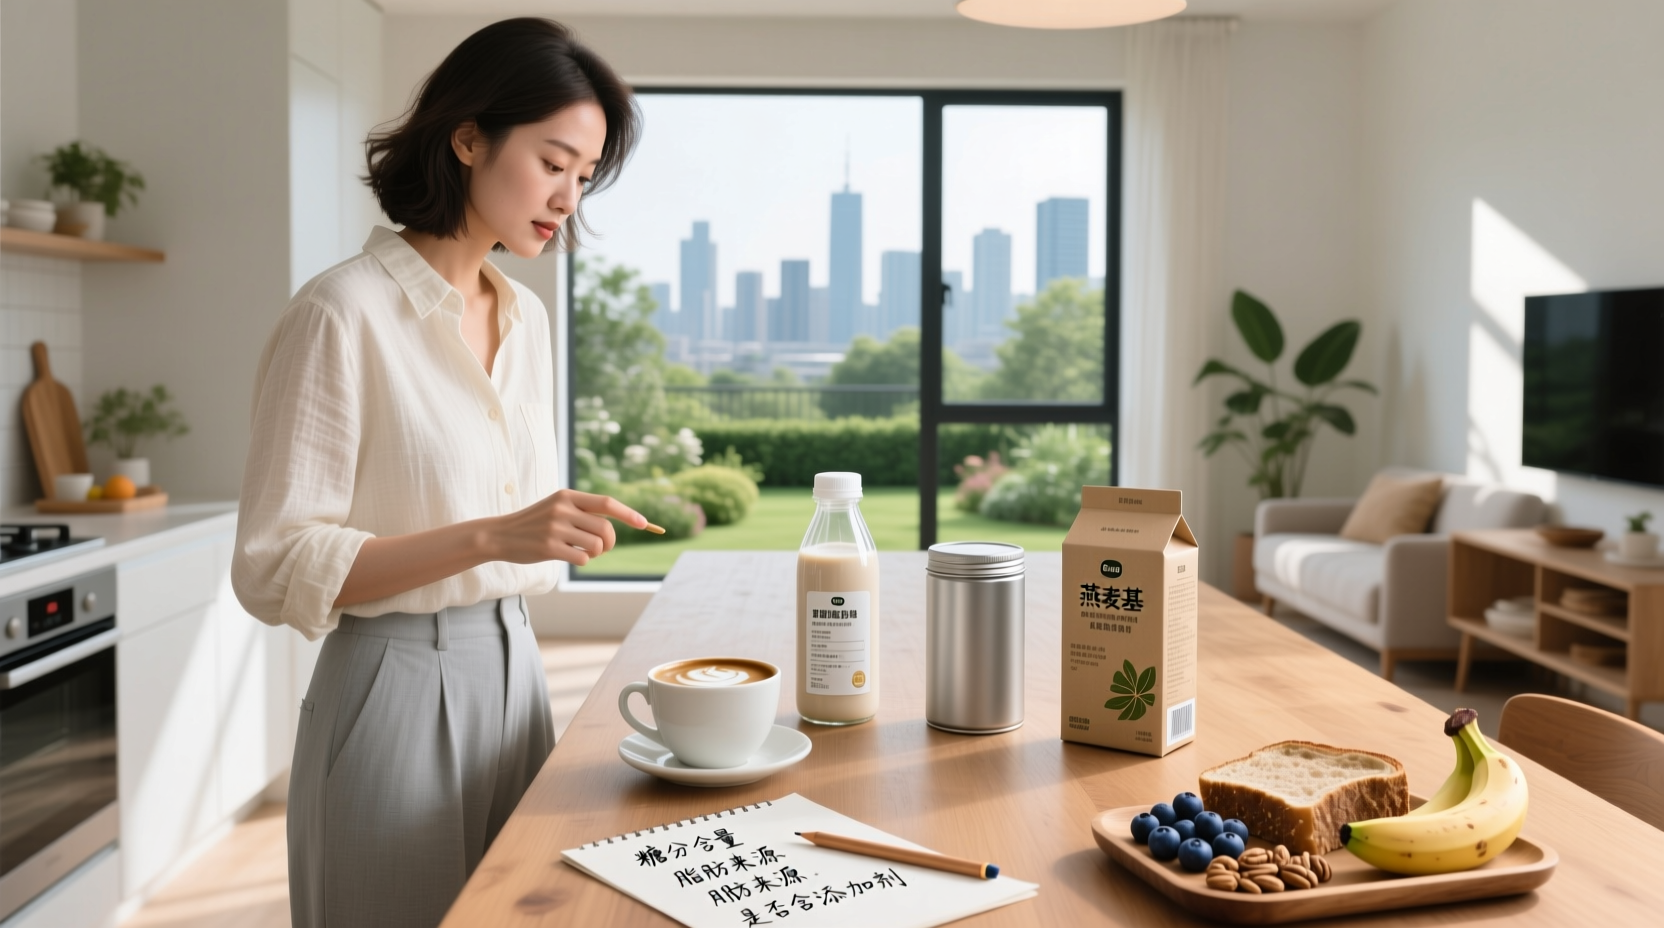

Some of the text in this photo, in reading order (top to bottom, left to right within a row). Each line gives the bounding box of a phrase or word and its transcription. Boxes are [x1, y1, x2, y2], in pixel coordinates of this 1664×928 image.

[1080, 583, 1144, 612] 燕麦基
[634, 828, 745, 867] 糖分含量
[674, 845, 786, 888] 脂肪来源
[740, 868, 907, 928] 是否含添加剂
